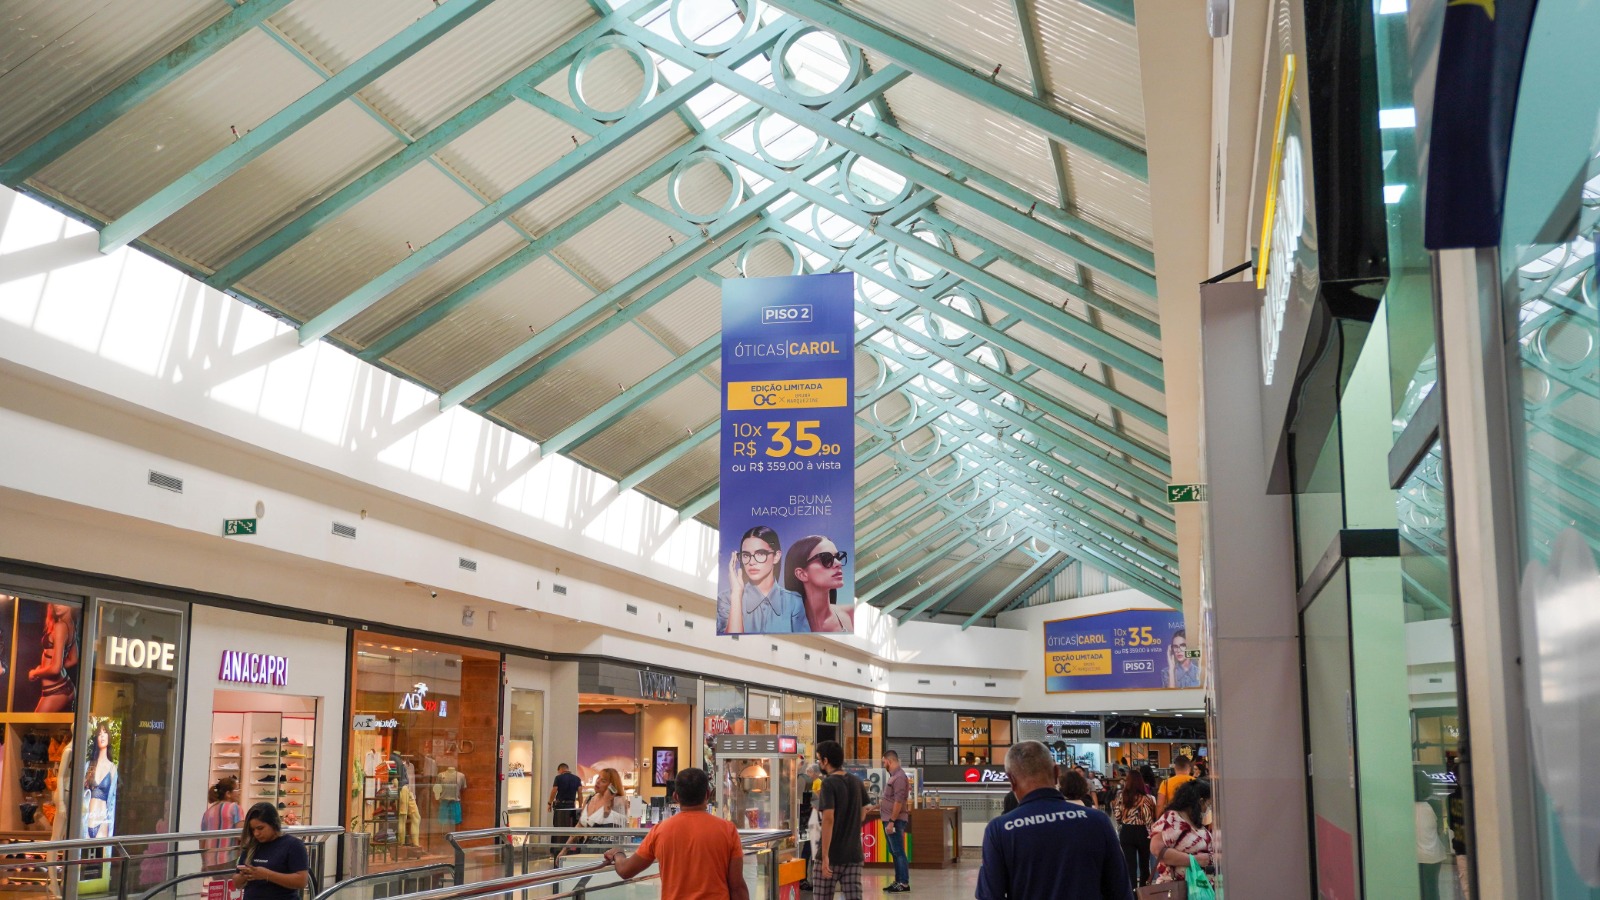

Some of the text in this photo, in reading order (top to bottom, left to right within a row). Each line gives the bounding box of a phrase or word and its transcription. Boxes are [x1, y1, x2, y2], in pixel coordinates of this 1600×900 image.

[765, 307, 810, 320] PISO 2
[789, 341, 840, 356] CAROL
[751, 383, 823, 393] EDIÇÃO LIMITADA
[732, 423, 762, 438] 10x
[733, 440, 757, 458] R$
[731, 460, 841, 473] ou R$ 359,00 à vista
[789, 494, 833, 505] BRUNA
[751, 505, 832, 517] MARQUEZINE
[1113, 628, 1127, 637] 10x
[1078, 634, 1107, 645] CAROL
[1114, 638, 1126, 647] R$
[107, 636, 175, 671] HOPE
[1052, 653, 1103, 662] EDIÇÃO LIMITADA
[219, 650, 289, 686] ANACAPRI
[1125, 661, 1152, 671] PISO 2
[1003, 809, 1088, 831] CONDUTOR
